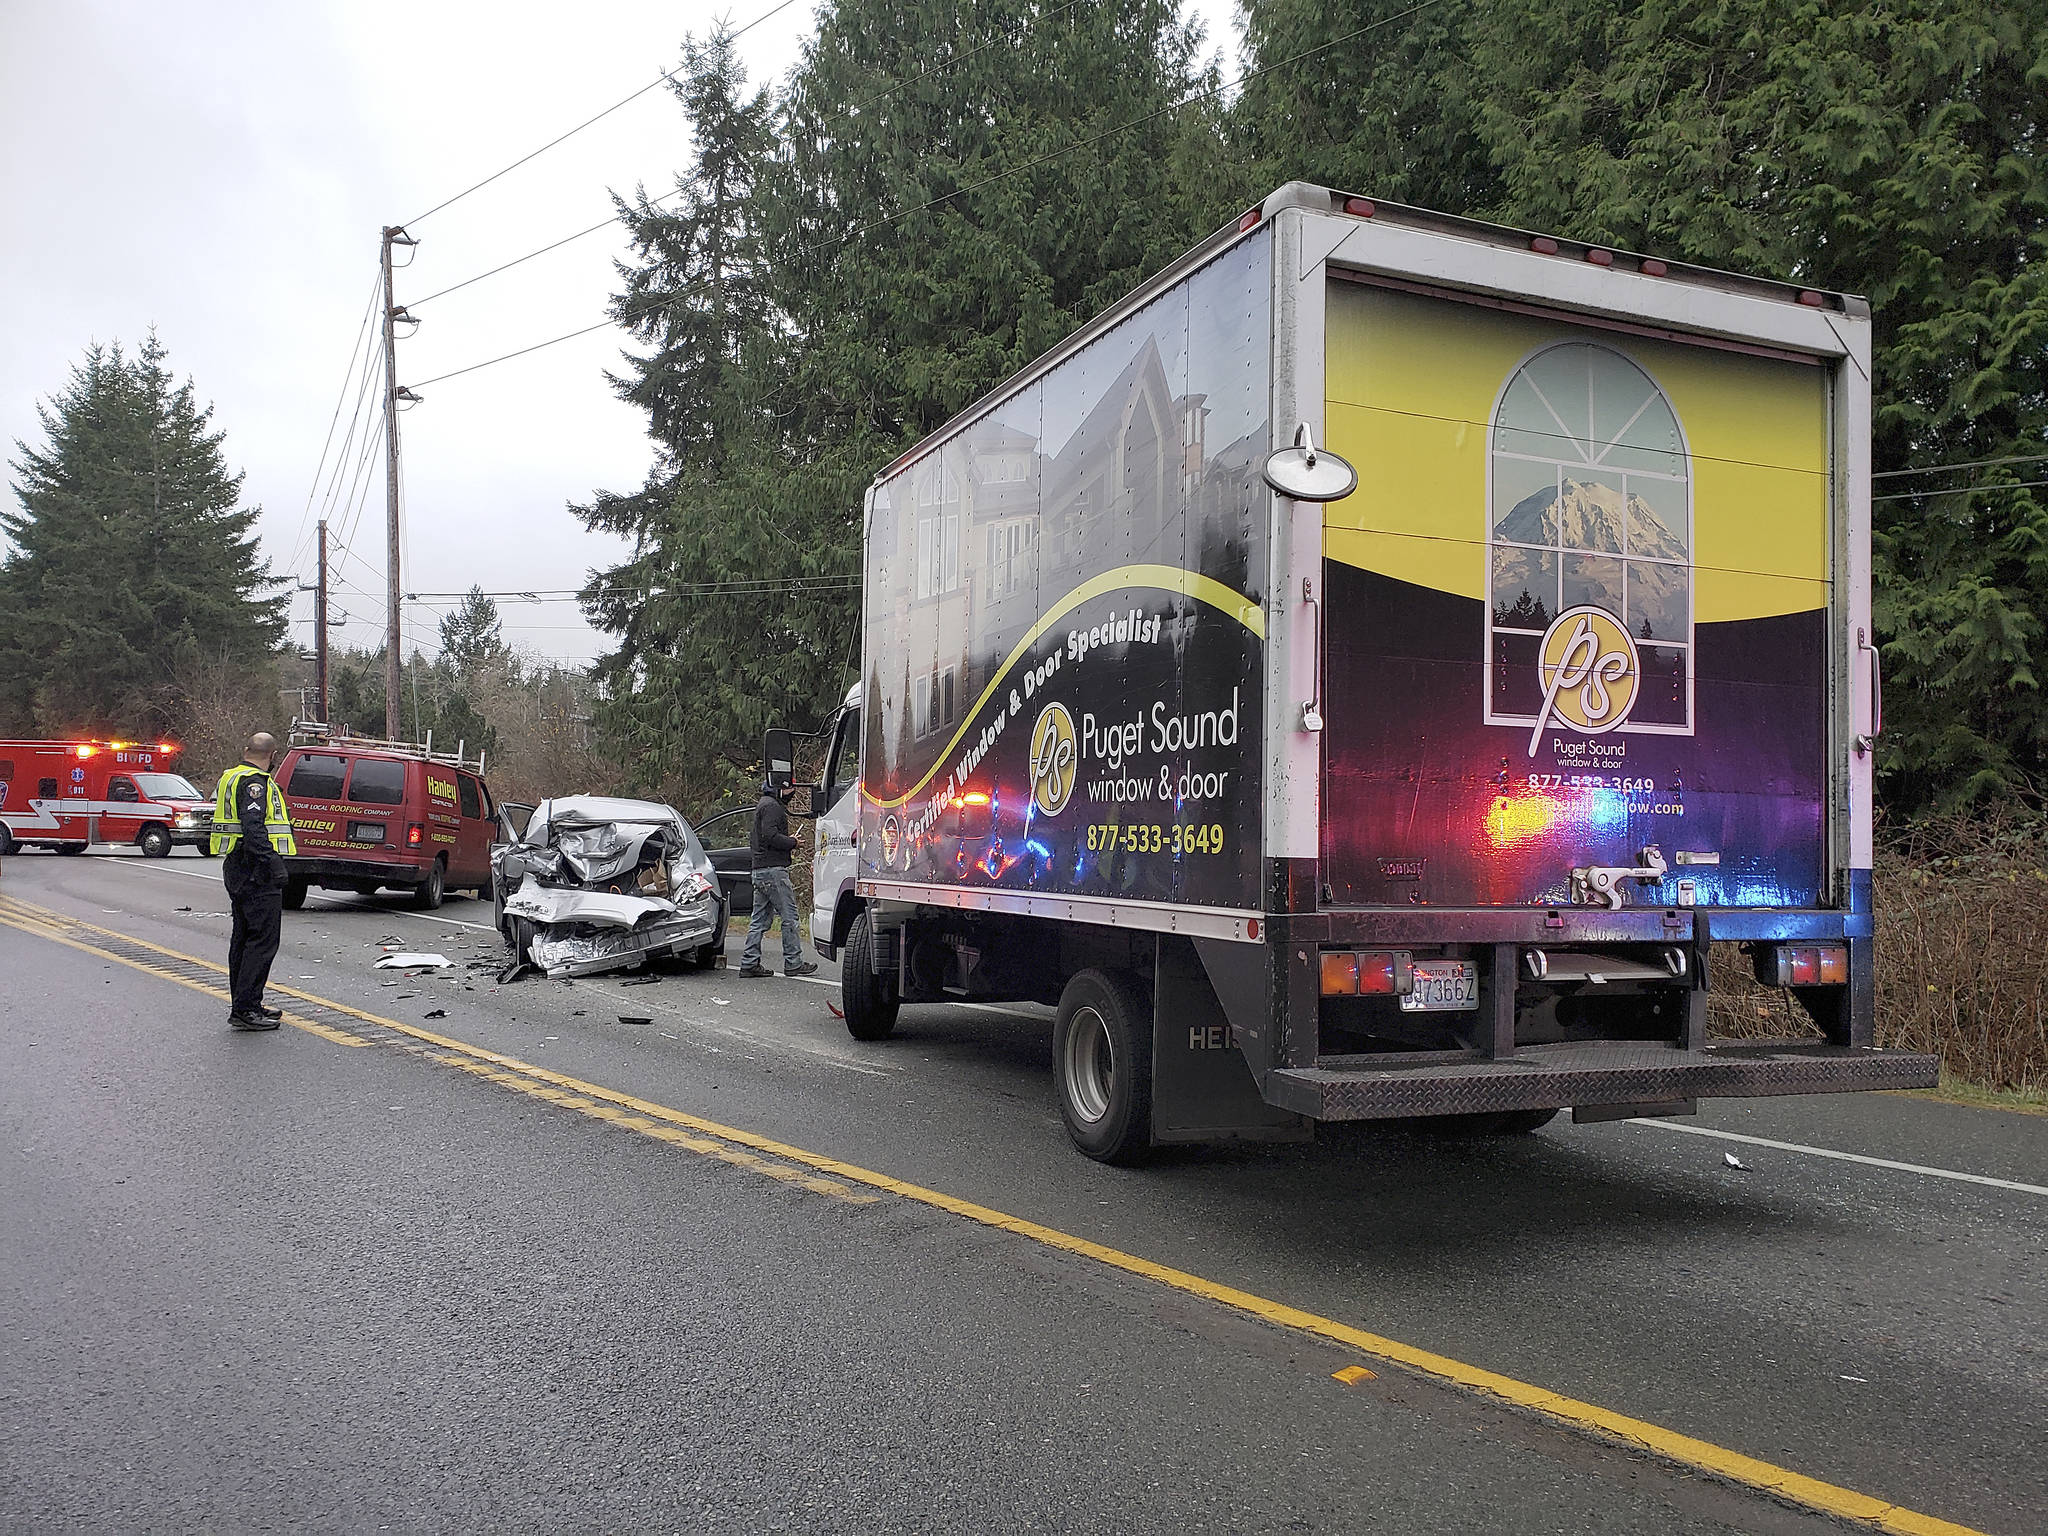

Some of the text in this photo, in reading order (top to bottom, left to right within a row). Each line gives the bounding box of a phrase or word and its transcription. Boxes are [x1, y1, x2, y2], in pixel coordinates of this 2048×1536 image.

[906, 608, 1162, 842] Certified Window & Door Specialist
[1082, 686, 1239, 770] Puget Sound
[1553, 738, 1626, 757] Puget Sound
[1556, 756, 1623, 769] window & door
[427, 775, 457, 804] Hanley
[1087, 759, 1229, 803] window & door
[329, 804, 363, 814] ROOFING
[1087, 823, 1225, 855] 877-533-3649
